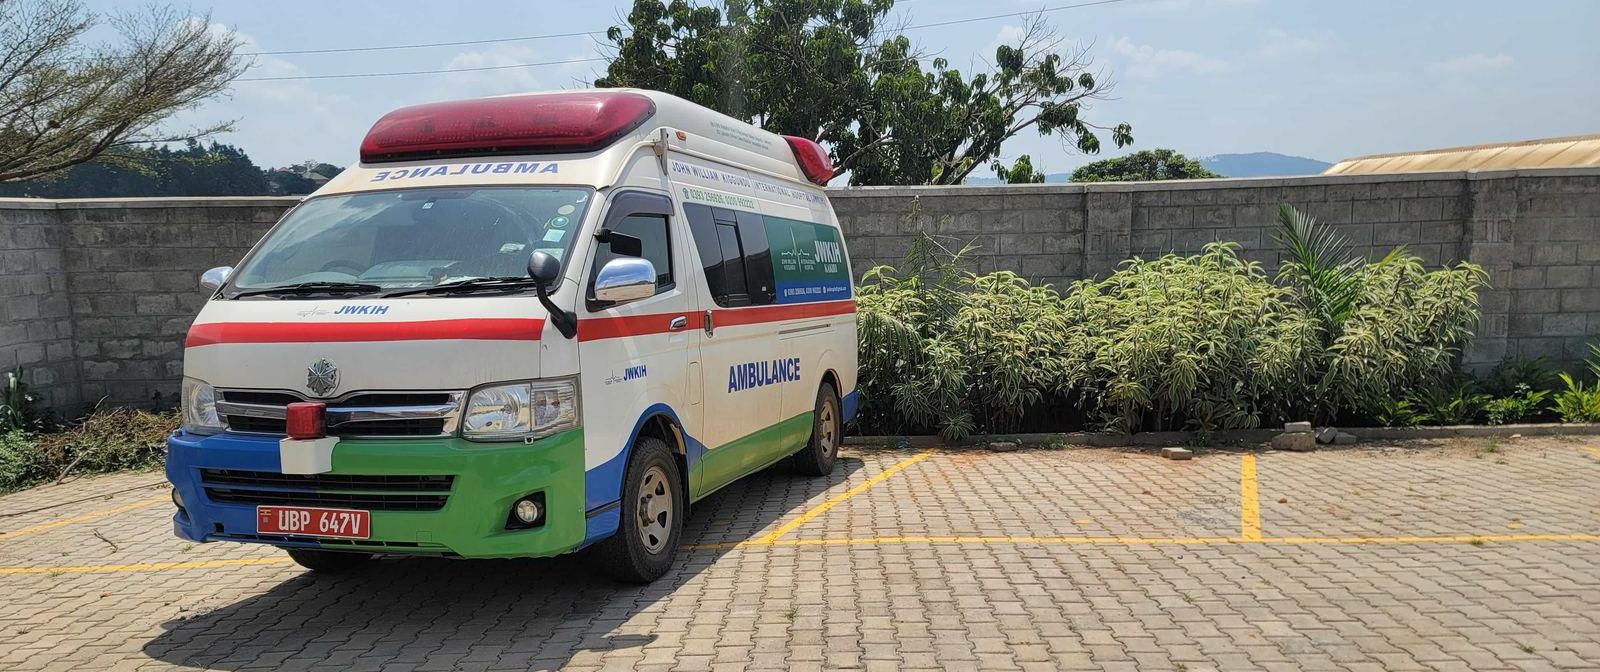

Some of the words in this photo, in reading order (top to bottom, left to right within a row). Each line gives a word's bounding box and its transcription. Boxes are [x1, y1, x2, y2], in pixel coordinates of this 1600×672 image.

[672, 161, 691, 175] JOHN
[691, 165, 720, 181] WILLIAM
[814, 240, 841, 263] JWKIH
[334, 305, 390, 315] JWKIH
[623, 365, 647, 381] JWKIH
[728, 357, 800, 393] AMBULANCE
[278, 510, 311, 531] UBP
[319, 512, 361, 535] 647V
